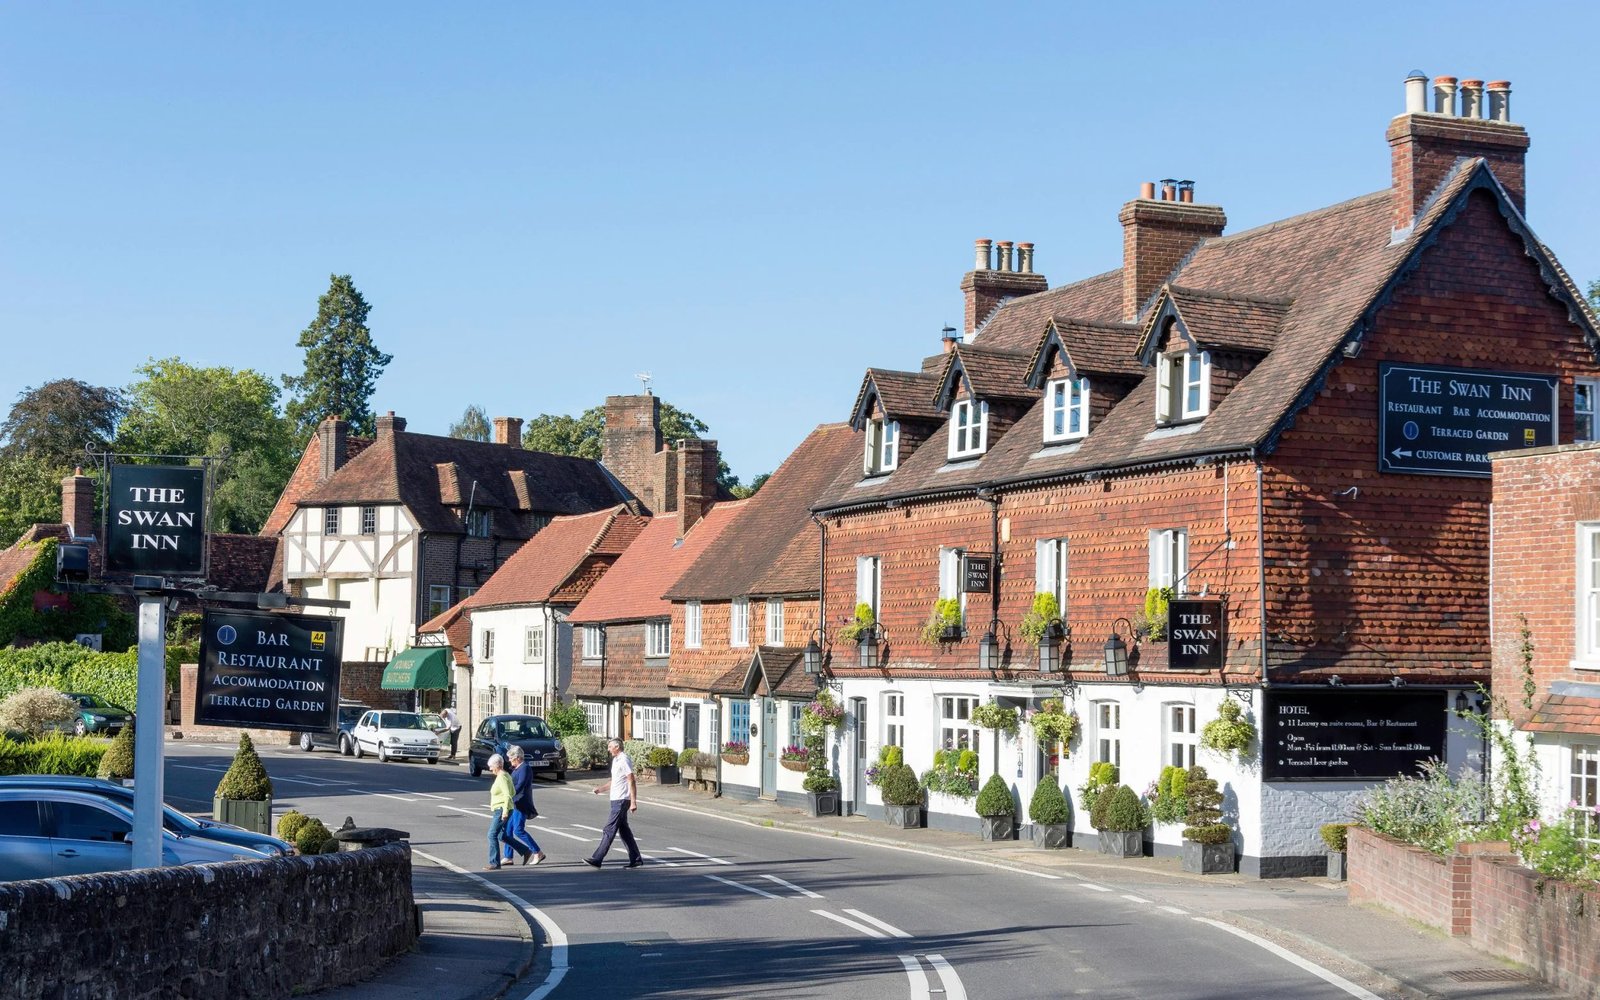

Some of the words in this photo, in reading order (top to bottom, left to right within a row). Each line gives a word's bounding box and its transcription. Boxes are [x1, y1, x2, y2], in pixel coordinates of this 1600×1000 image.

[1408, 376, 1442, 395] THE
[1449, 379, 1491, 399] SWAN
[1501, 383, 1533, 402] INN
[1388, 401, 1443, 415] RESTAURANT
[1453, 406, 1471, 417] BAR
[1477, 408, 1551, 422] ACCOMMODATION
[1430, 426, 1474, 439] TERRACED
[1475, 429, 1509, 441] GARDEN
[1415, 449, 1463, 462] CUSTOMER
[129, 486, 185, 504] THE
[118, 509, 195, 528] SWAN
[131, 533, 180, 550] INN
[970, 563, 986, 571] THE
[967, 571, 989, 580] SWAN
[971, 580, 985, 588] INN
[1179, 614, 1212, 625] THE
[257, 630, 290, 647] BAR
[313, 632, 324, 641] AA
[1173, 629, 1218, 640] SWAN
[1182, 644, 1210, 655] INN
[217, 650, 324, 671] RESTAURANT
[212, 673, 325, 692] ACCOMMODATION
[208, 693, 271, 709] TERRACED
[275, 697, 325, 712] GARDEN
[1279, 705, 1310, 715] HOTEL
[1366, 719, 1378, 727] Bar
[1386, 719, 1418, 727] Restaurant
[1287, 733, 1305, 743] Open
[1363, 743, 1374, 751] Sat
[1379, 743, 1392, 751] Sun
[1287, 757, 1313, 766] Terraced
[1313, 757, 1327, 766] beer
[1327, 757, 1349, 767] garden
